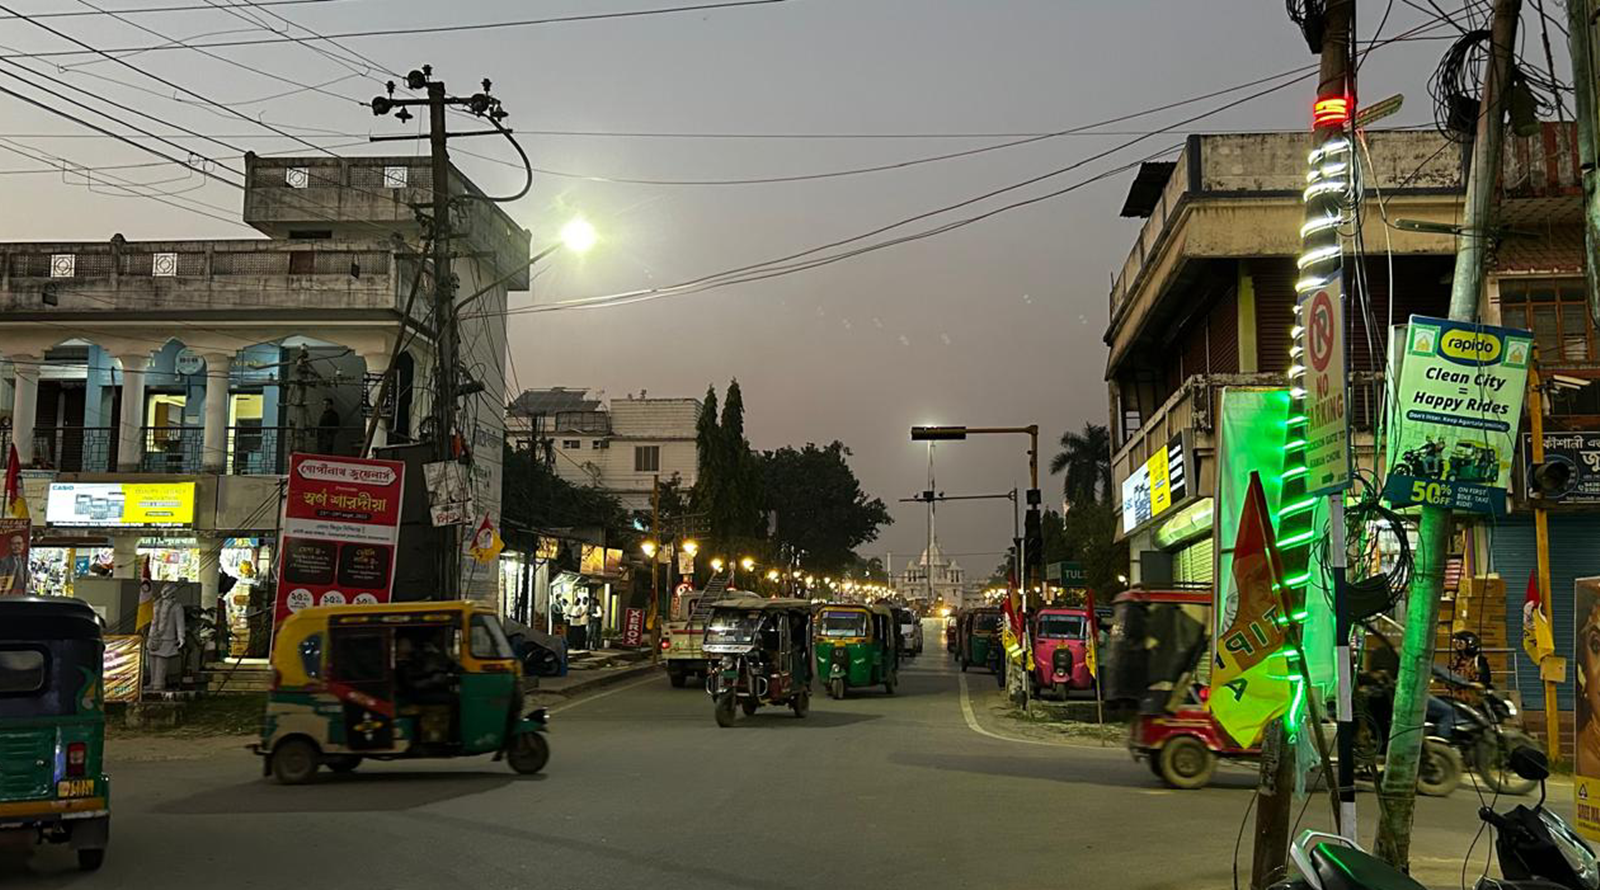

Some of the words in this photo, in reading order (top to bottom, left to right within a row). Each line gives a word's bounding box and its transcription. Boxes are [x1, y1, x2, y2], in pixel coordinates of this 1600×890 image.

[1448, 338, 1493, 353] rapido
[1316, 373, 1329, 401] NO
[1426, 367, 1470, 384] Clean
[1474, 374, 1507, 392] City
[1413, 391, 1464, 411] Happy
[1466, 398, 1509, 415] Rides
[1409, 412, 1425, 420] Don't
[1442, 416, 1457, 424] Keep
[1433, 495, 1450, 505] OFF
[1469, 488, 1487, 496] FIRST
[627, 610, 640, 645] XEROX
